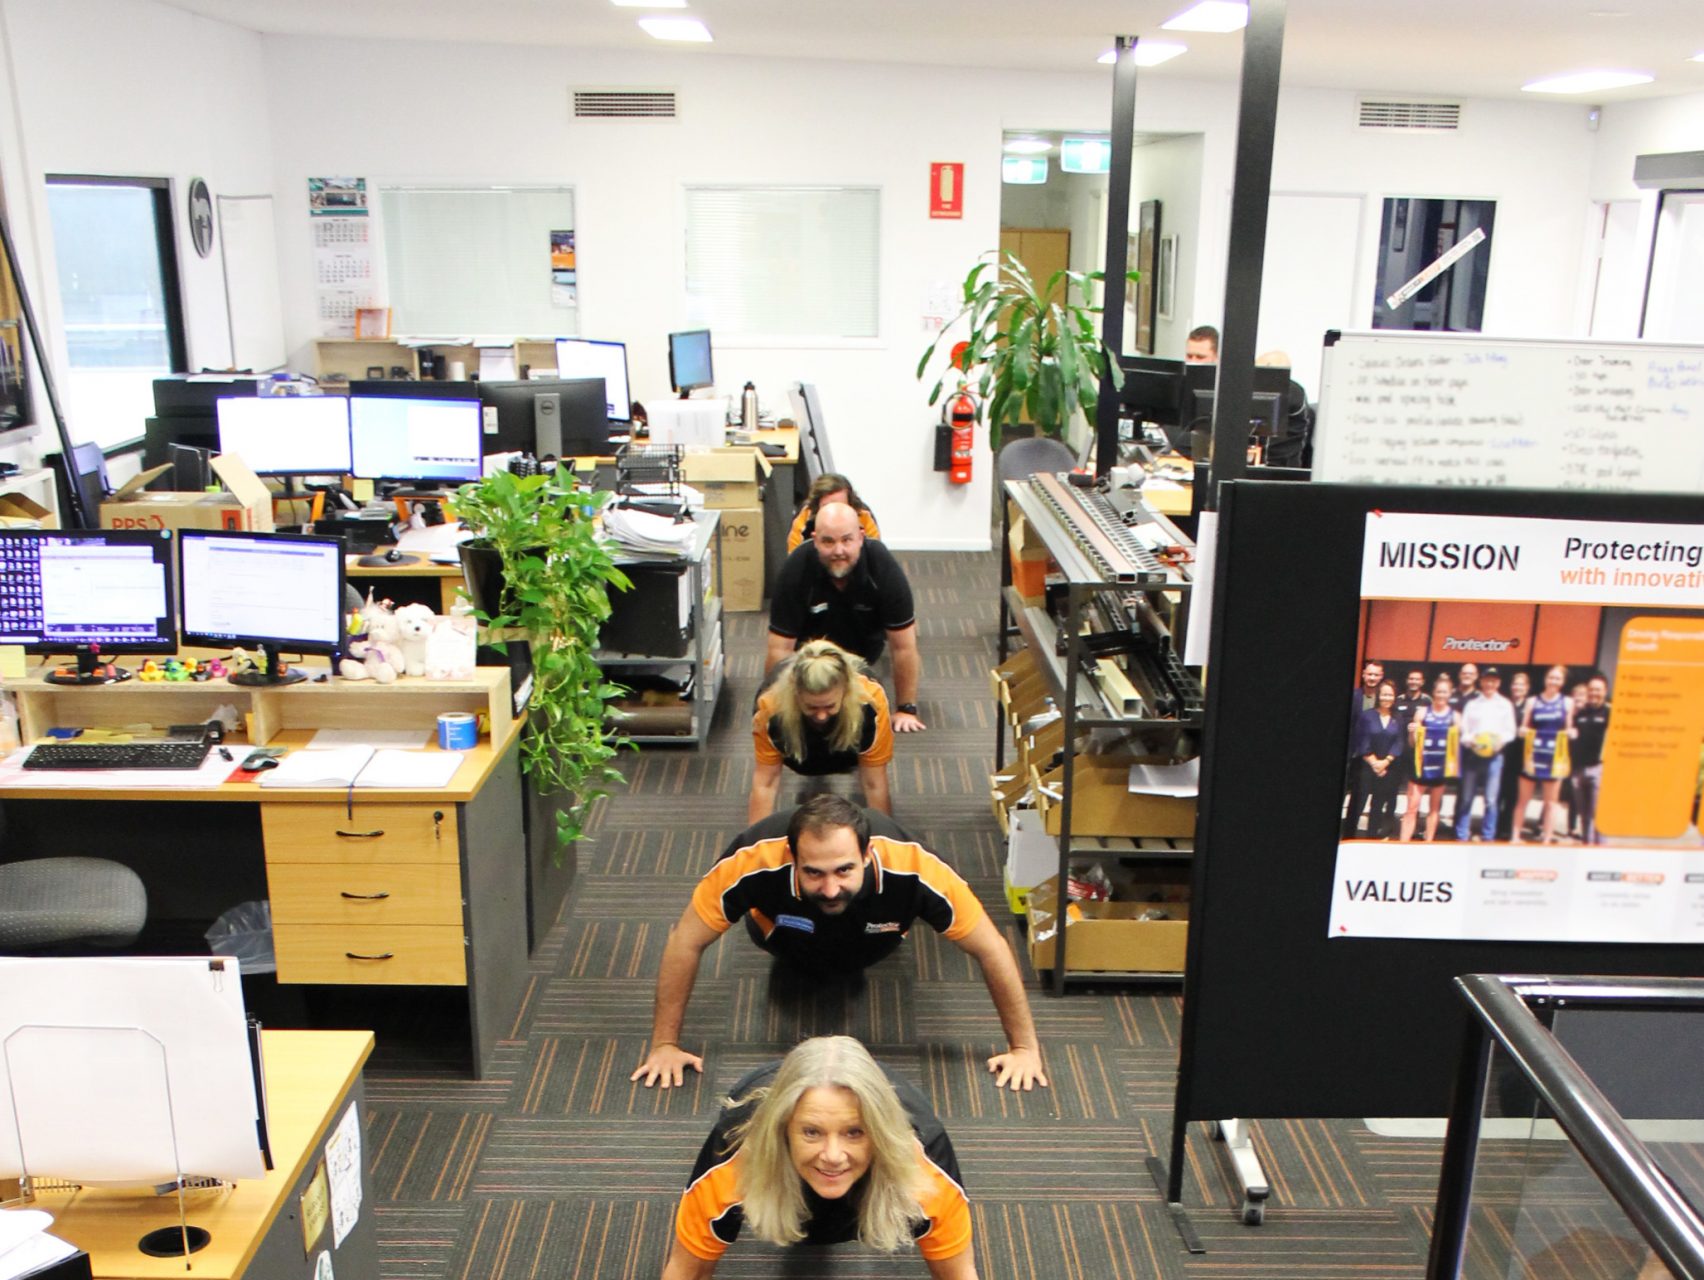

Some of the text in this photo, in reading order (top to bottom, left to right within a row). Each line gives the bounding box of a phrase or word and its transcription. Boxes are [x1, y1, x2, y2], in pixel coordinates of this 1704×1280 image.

[112, 517, 149, 530] PPS
[1379, 541, 1520, 571] MISSION
[1563, 537, 1704, 568] Protecting
[1560, 566, 1704, 588] with innovati
[1441, 635, 1511, 652] Protector
[1345, 880, 1453, 903] VALUES
